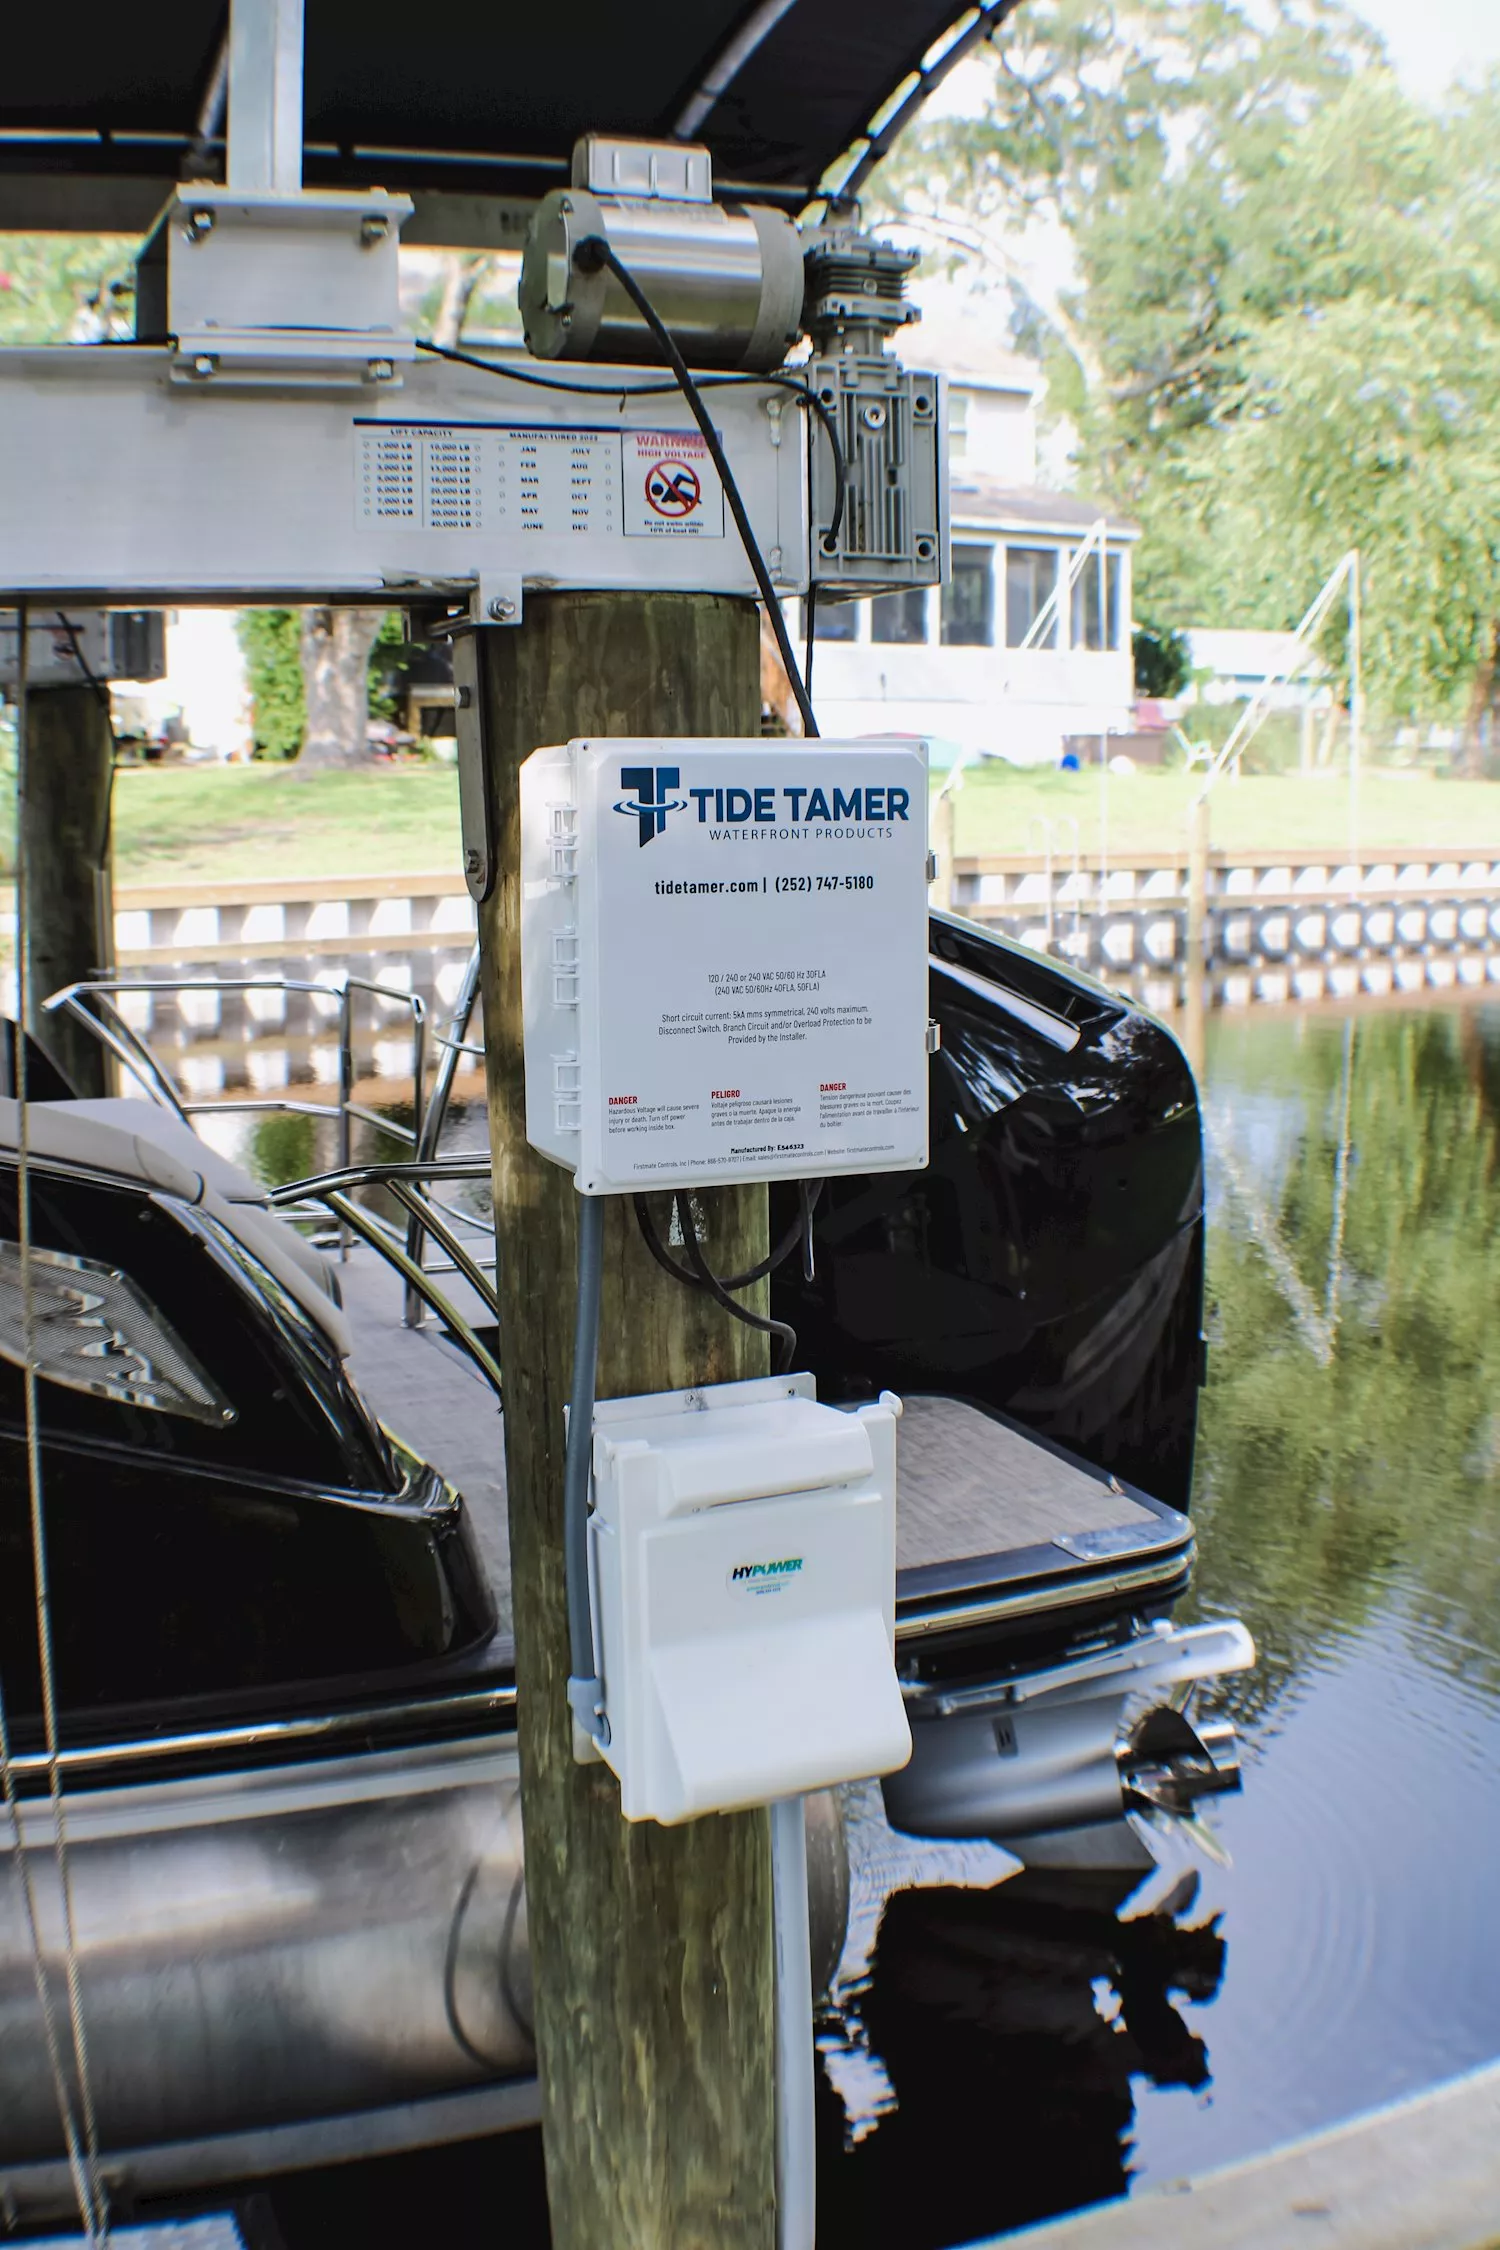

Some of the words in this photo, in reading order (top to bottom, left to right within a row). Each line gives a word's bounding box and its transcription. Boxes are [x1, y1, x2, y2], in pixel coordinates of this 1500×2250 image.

[510, 432, 577, 441] MANUFACTURED
[459, 444, 470, 452] LB
[664, 450, 705, 459] VOLTAGE
[460, 476, 470, 484] LB
[460, 487, 470, 495] LB
[460, 520, 471, 528] LB
[690, 788, 775, 822] TIDE
[784, 788, 909, 821] TAMER
[709, 829, 808, 840] WATERFRONT
[816, 828, 892, 839] PRODUCTS
[655, 881, 758, 894] tidetamer.com
[776, 876, 811, 893] (252)
[816, 876, 873, 890] 747-5180
[708, 975, 719, 983] 120
[726, 974, 738, 983] 240
[748, 973, 761, 981] 240
[762, 972, 774, 980] VAC
[776, 971, 795, 980] 50/60
[797, 971, 804, 979] Hz
[806, 970, 826, 979] 30FLA
[715, 986, 729, 996] (240
[732, 985, 743, 994] VAC
[745, 984, 772, 993] 50/60Hz
[798, 983, 820, 992] 50FLA)
[662, 1014, 680, 1022] Short
[682, 1013, 703, 1021] circuit
[705, 1012, 731, 1020] current:
[733, 1011, 745, 1019] 5kA
[807, 1007, 819, 1015] 240
[820, 1006, 835, 1014] volts
[659, 1026, 695, 1035] Disconnect
[723, 1023, 746, 1032] Branch
[748, 1022, 769, 1030] Circuit
[771, 1020, 792, 1029] and/or
[794, 1018, 821, 1029] Overload
[823, 1017, 855, 1026] Protection
[728, 1035, 756, 1044] Provided
[758, 1035, 765, 1043] by
[767, 1034, 778, 1042] the
[779, 1032, 807, 1042] Installer.
[820, 1083, 846, 1092] DANGER
[711, 1089, 740, 1099] PELIGRO
[608, 1096, 637, 1105] DANGER
[711, 1101, 727, 1109] Voltaje
[729, 1100, 751, 1108] peligroso
[843, 1101, 858, 1109] graves
[637, 1106, 656, 1114] Voltage
[711, 1110, 727, 1119] graves
[759, 1107, 776, 1115] Apague
[608, 1117, 623, 1125] injury
[733, 1117, 753, 1125] trabajar
[754, 1116, 770, 1124] dentro
[627, 1125, 647, 1133] working
[730, 1145, 766, 1154] Manufactured
[767, 1144, 776, 1153] By:
[634, 1161, 656, 1170] Firstmate
[733, 1559, 802, 1580] HYPOWER
